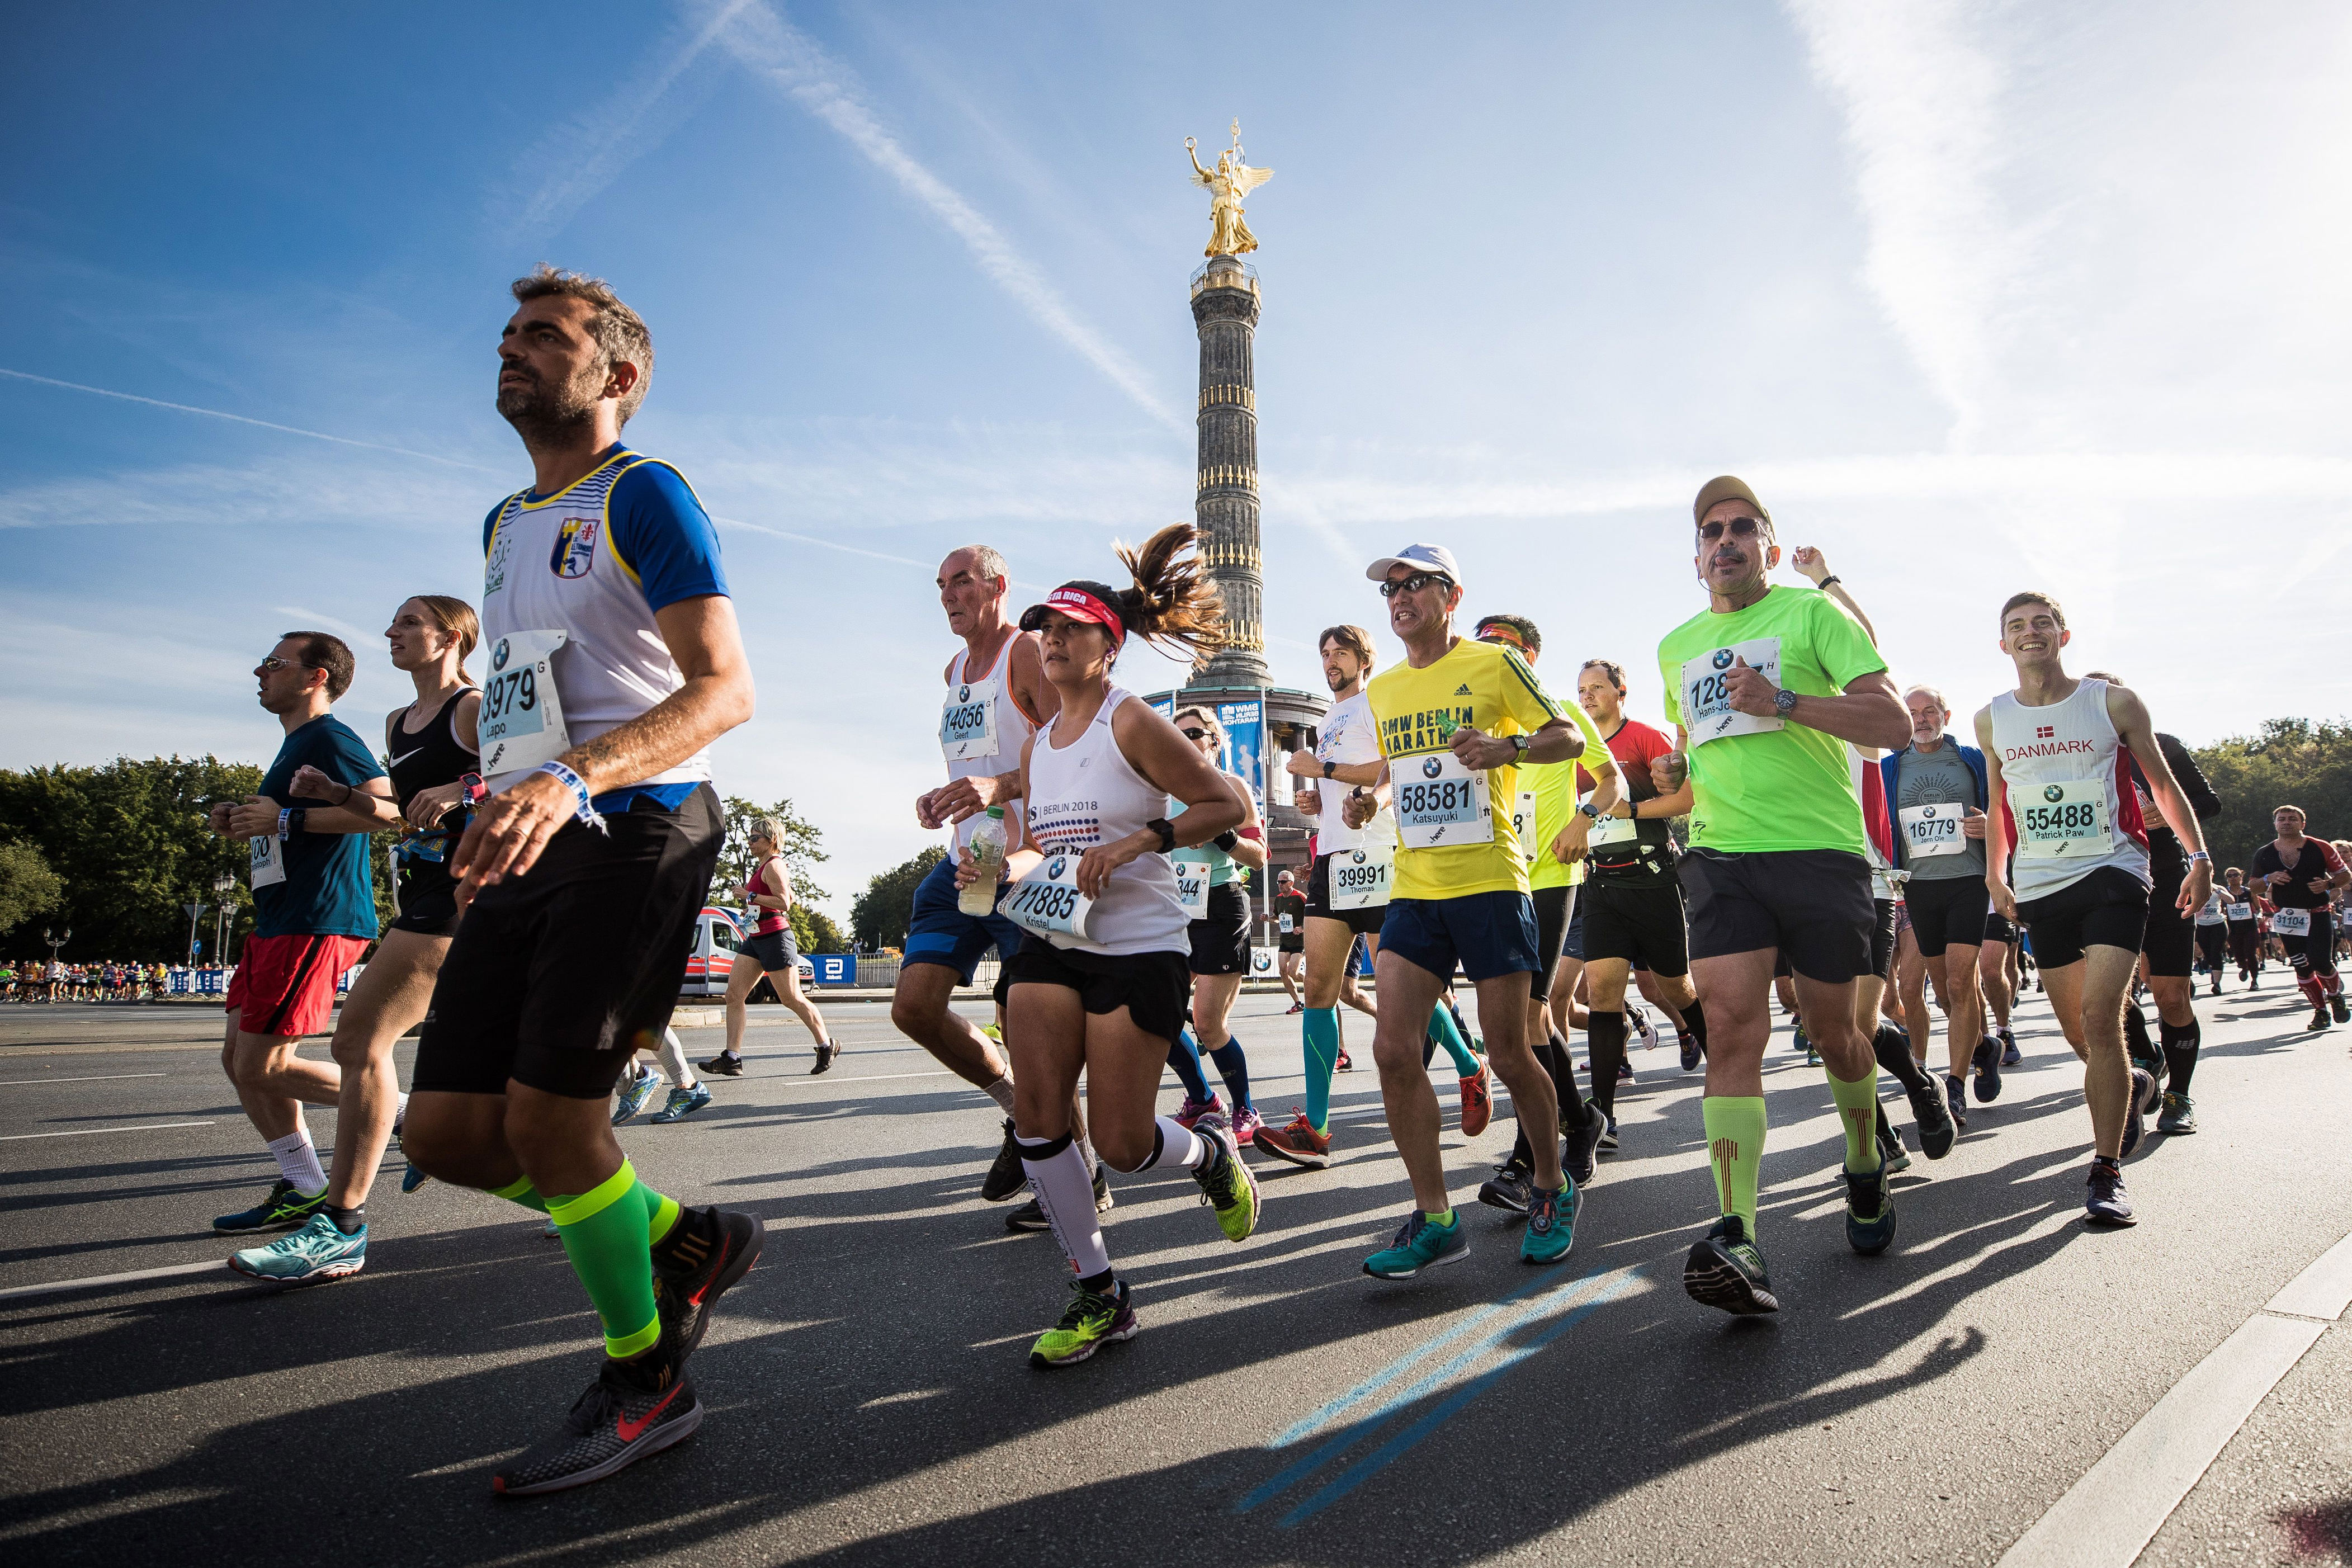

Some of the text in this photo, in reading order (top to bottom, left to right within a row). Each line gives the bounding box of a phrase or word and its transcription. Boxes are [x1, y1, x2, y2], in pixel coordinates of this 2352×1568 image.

[1062, 591, 1087, 604] RICA
[537, 661, 545, 673] G
[1767, 662, 1774, 670] H
[479, 668, 535, 727] 3979
[944, 703, 984, 732] 14056
[1382, 714, 1412, 737] BMW
[1716, 715, 1734, 733] here
[487, 722, 506, 739] Lapo
[954, 731, 969, 740] Geert
[957, 742, 967, 755] here
[1385, 726, 1473, 755] MARATH
[489, 743, 506, 768] here
[2006, 739, 2095, 761] DANMARK
[1401, 780, 1470, 814] 58581
[1043, 802, 1069, 815] BERLIN
[1071, 801, 1098, 811] 2018
[1413, 811, 1458, 824] Katsuyuki
[2027, 804, 2094, 831] 55488
[1429, 826, 1446, 842] here
[1910, 819, 1956, 838] 16779
[2035, 829, 2085, 840] Patrick Paw
[1930, 844, 1939, 854] here
[2055, 840, 2069, 854] here
[1338, 865, 1385, 887] 39991
[1012, 884, 1079, 920] 11885
[1359, 894, 1369, 905] here
[1024, 915, 1050, 930] Kristel
[2277, 915, 2305, 925] 31104
